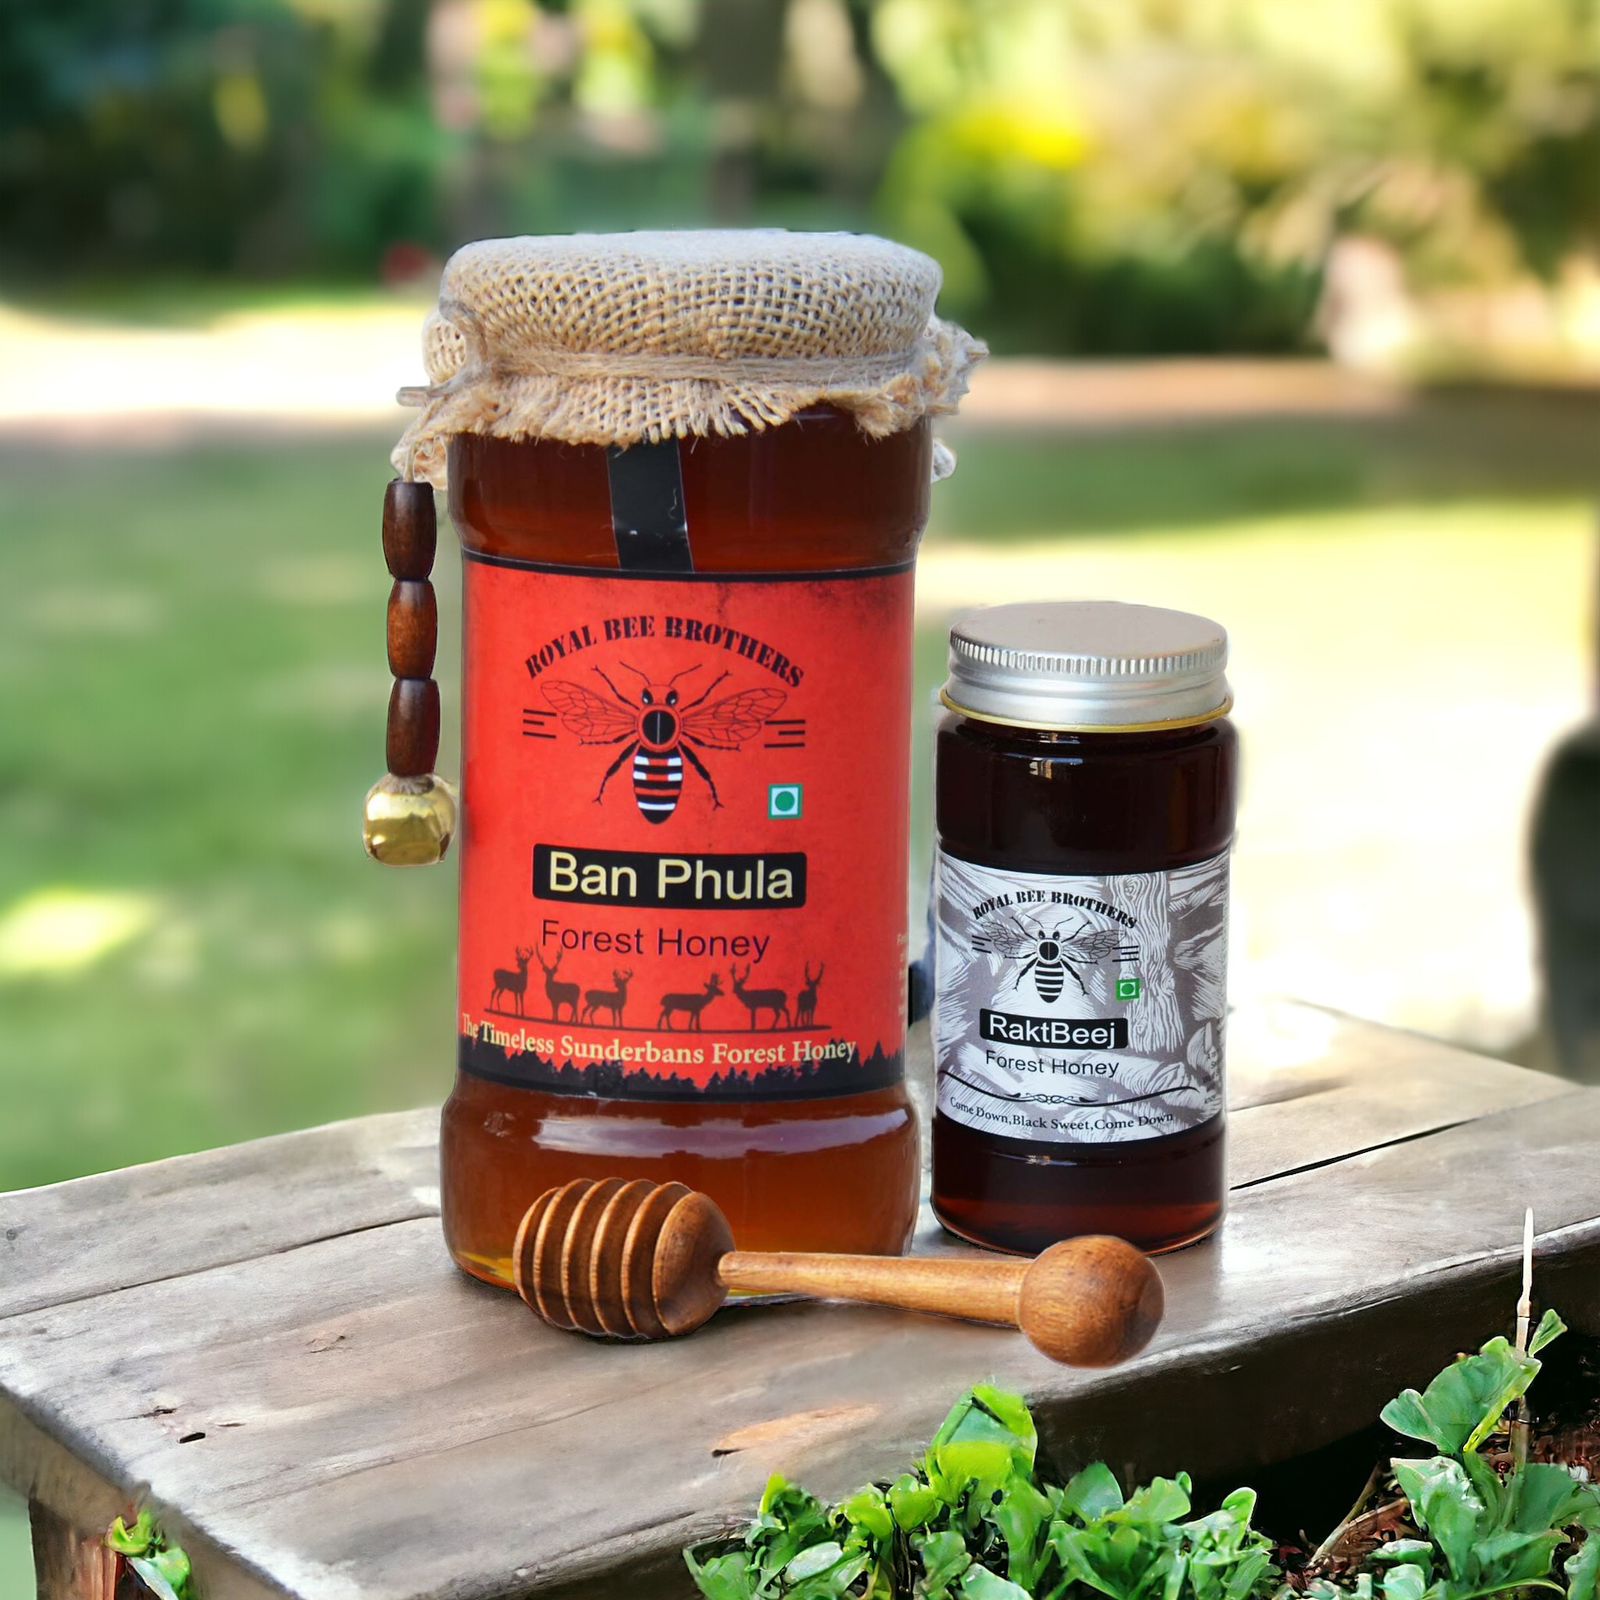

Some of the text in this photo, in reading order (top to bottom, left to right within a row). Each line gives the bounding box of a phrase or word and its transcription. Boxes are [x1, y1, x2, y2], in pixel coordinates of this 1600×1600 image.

[524, 615, 804, 688] ROYAL BEE BROTHERS
[549, 850, 793, 900] Ban Phula
[972, 890, 1137, 929] ROYAL BEE BROTHERS
[541, 920, 770, 964] Forest Honey
[462, 1013, 857, 1064] The Timeless Sunderbans Forest Honey
[989, 1013, 1115, 1049] RaktBeej
[985, 1050, 1120, 1078] Forest Honey
[950, 1097, 974, 1115] Come
[1138, 1112, 1174, 1126] Down
